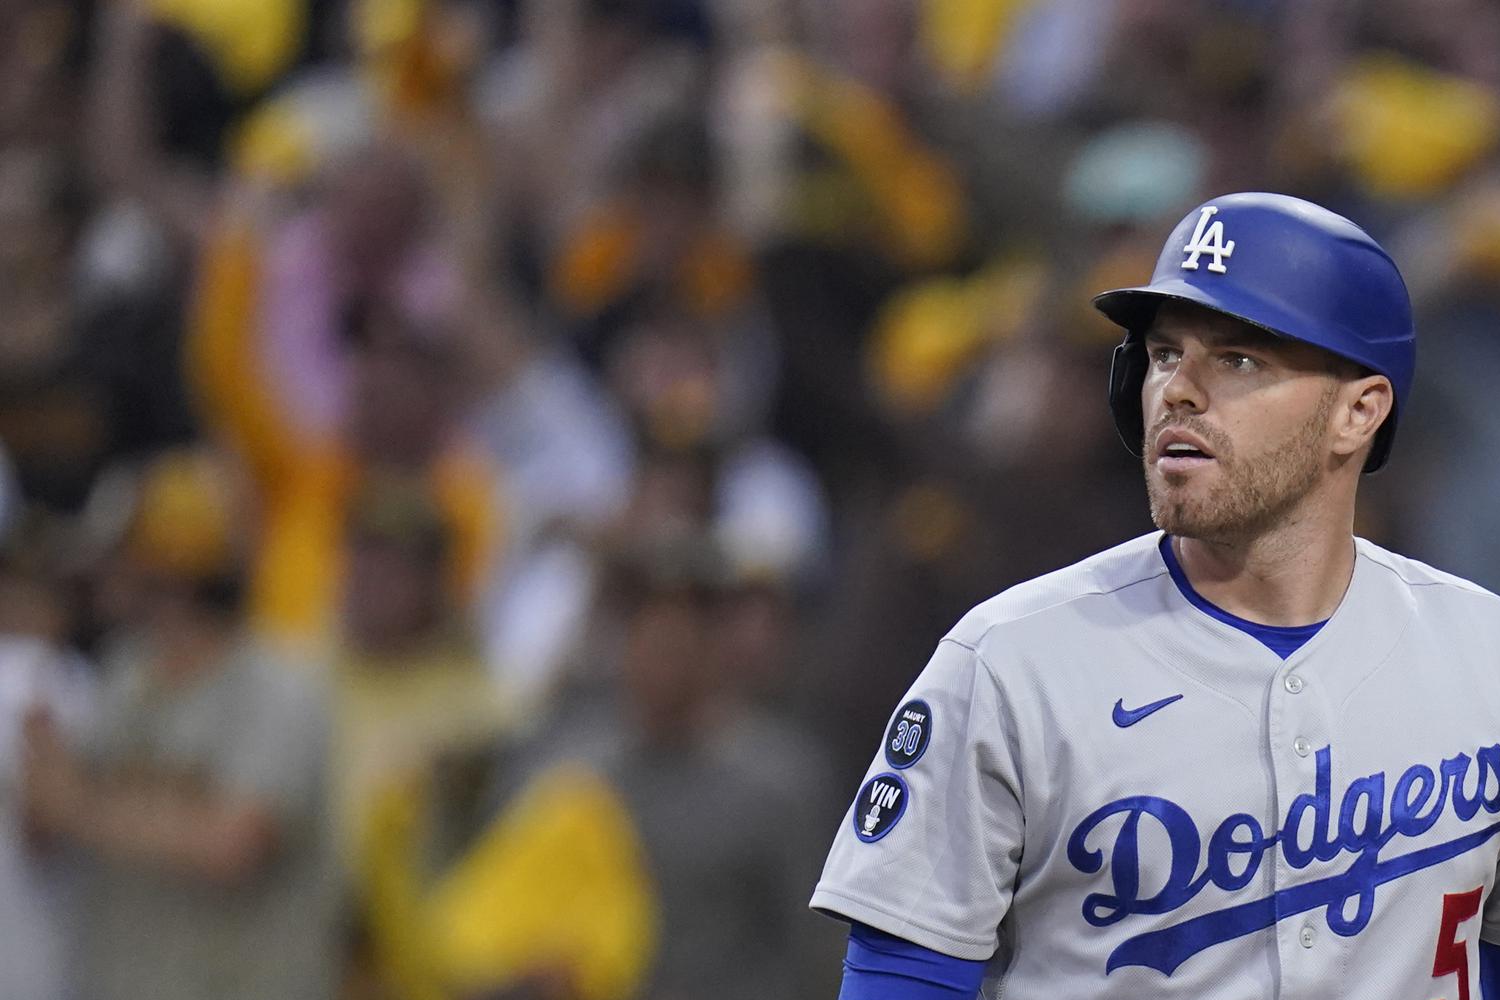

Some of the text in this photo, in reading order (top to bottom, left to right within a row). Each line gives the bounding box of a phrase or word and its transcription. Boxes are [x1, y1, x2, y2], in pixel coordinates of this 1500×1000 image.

[1181, 206, 1235, 273] LA
[903, 710, 926, 722] MAURY
[892, 720, 922, 756] 30
[870, 780, 901, 809] VIN
